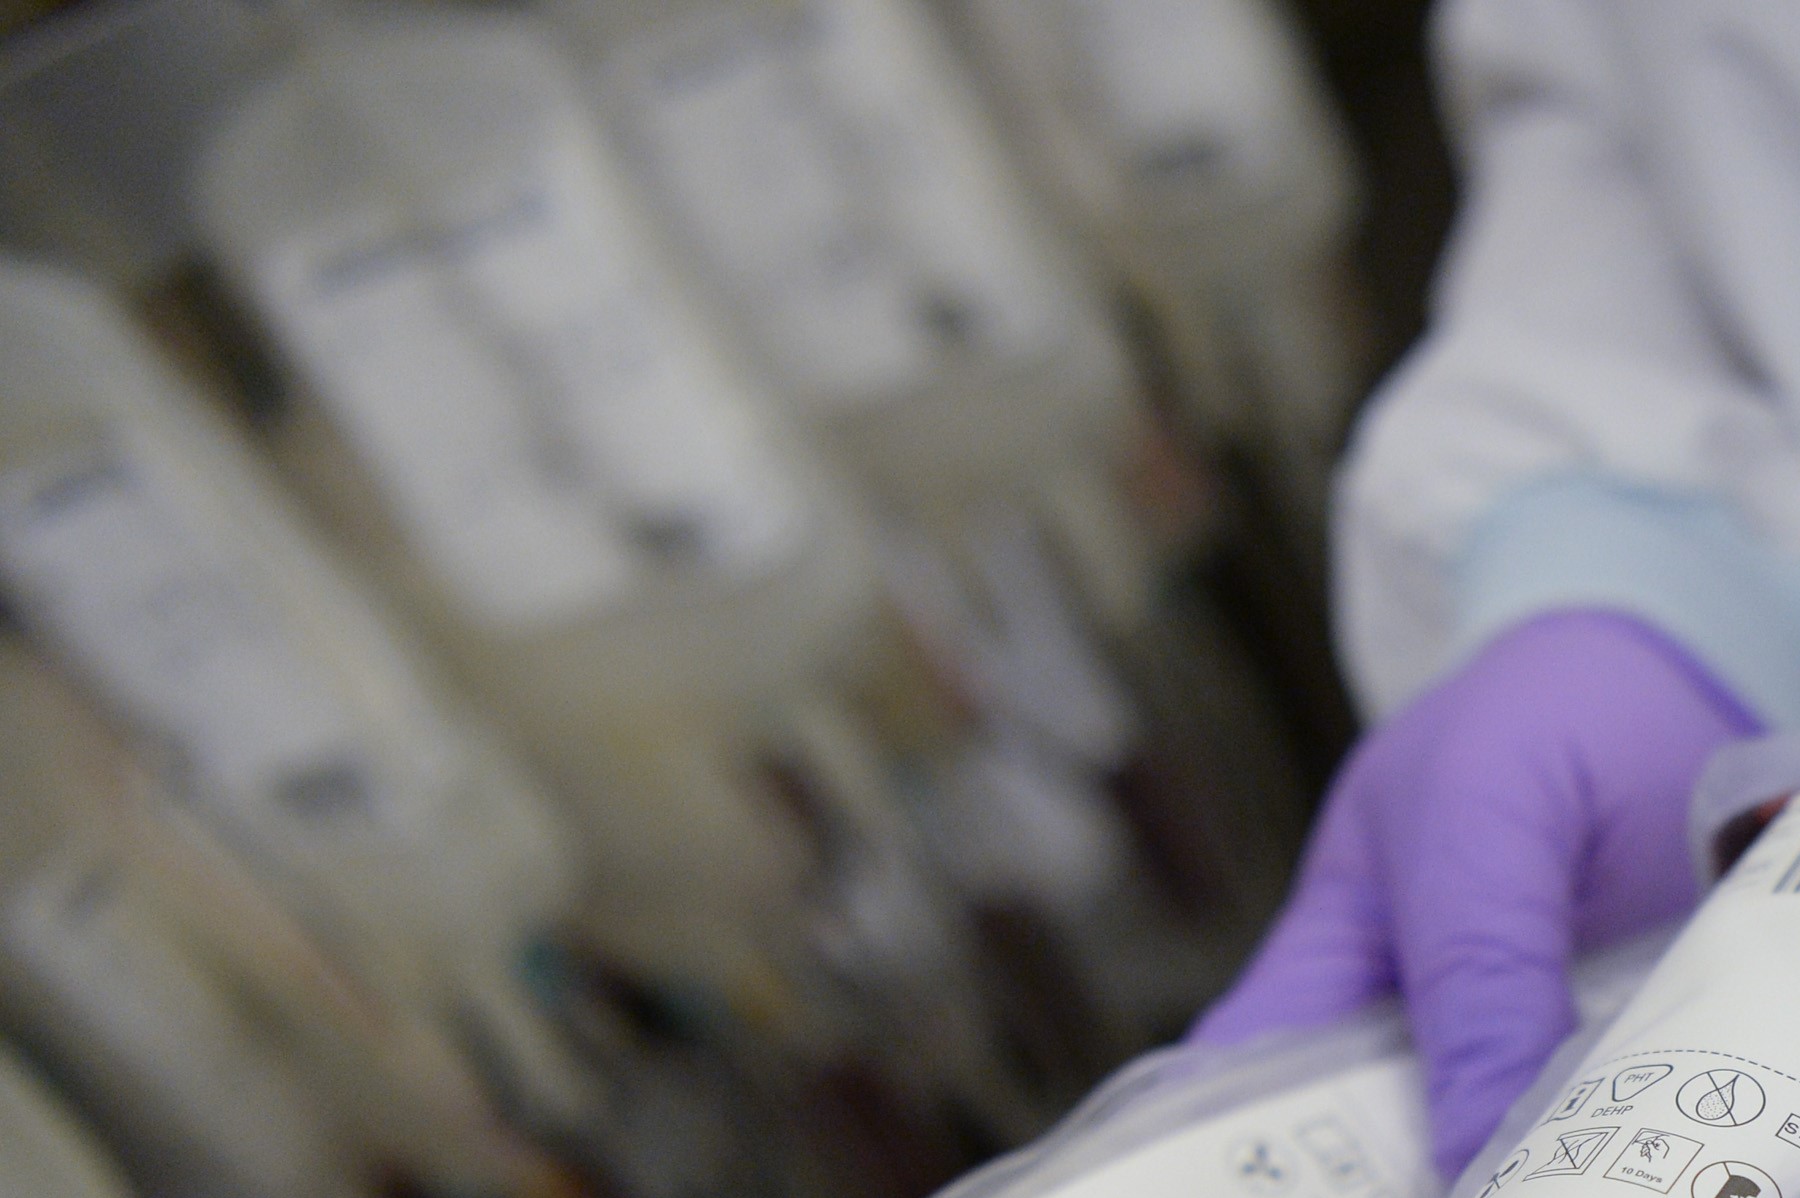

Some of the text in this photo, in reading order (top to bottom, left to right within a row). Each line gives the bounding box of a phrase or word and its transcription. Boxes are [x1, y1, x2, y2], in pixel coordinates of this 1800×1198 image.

[1624, 1071, 1655, 1084] PHT
[1590, 1105, 1634, 1118] DEHP
[1621, 1166, 1663, 1184] 10 Days
